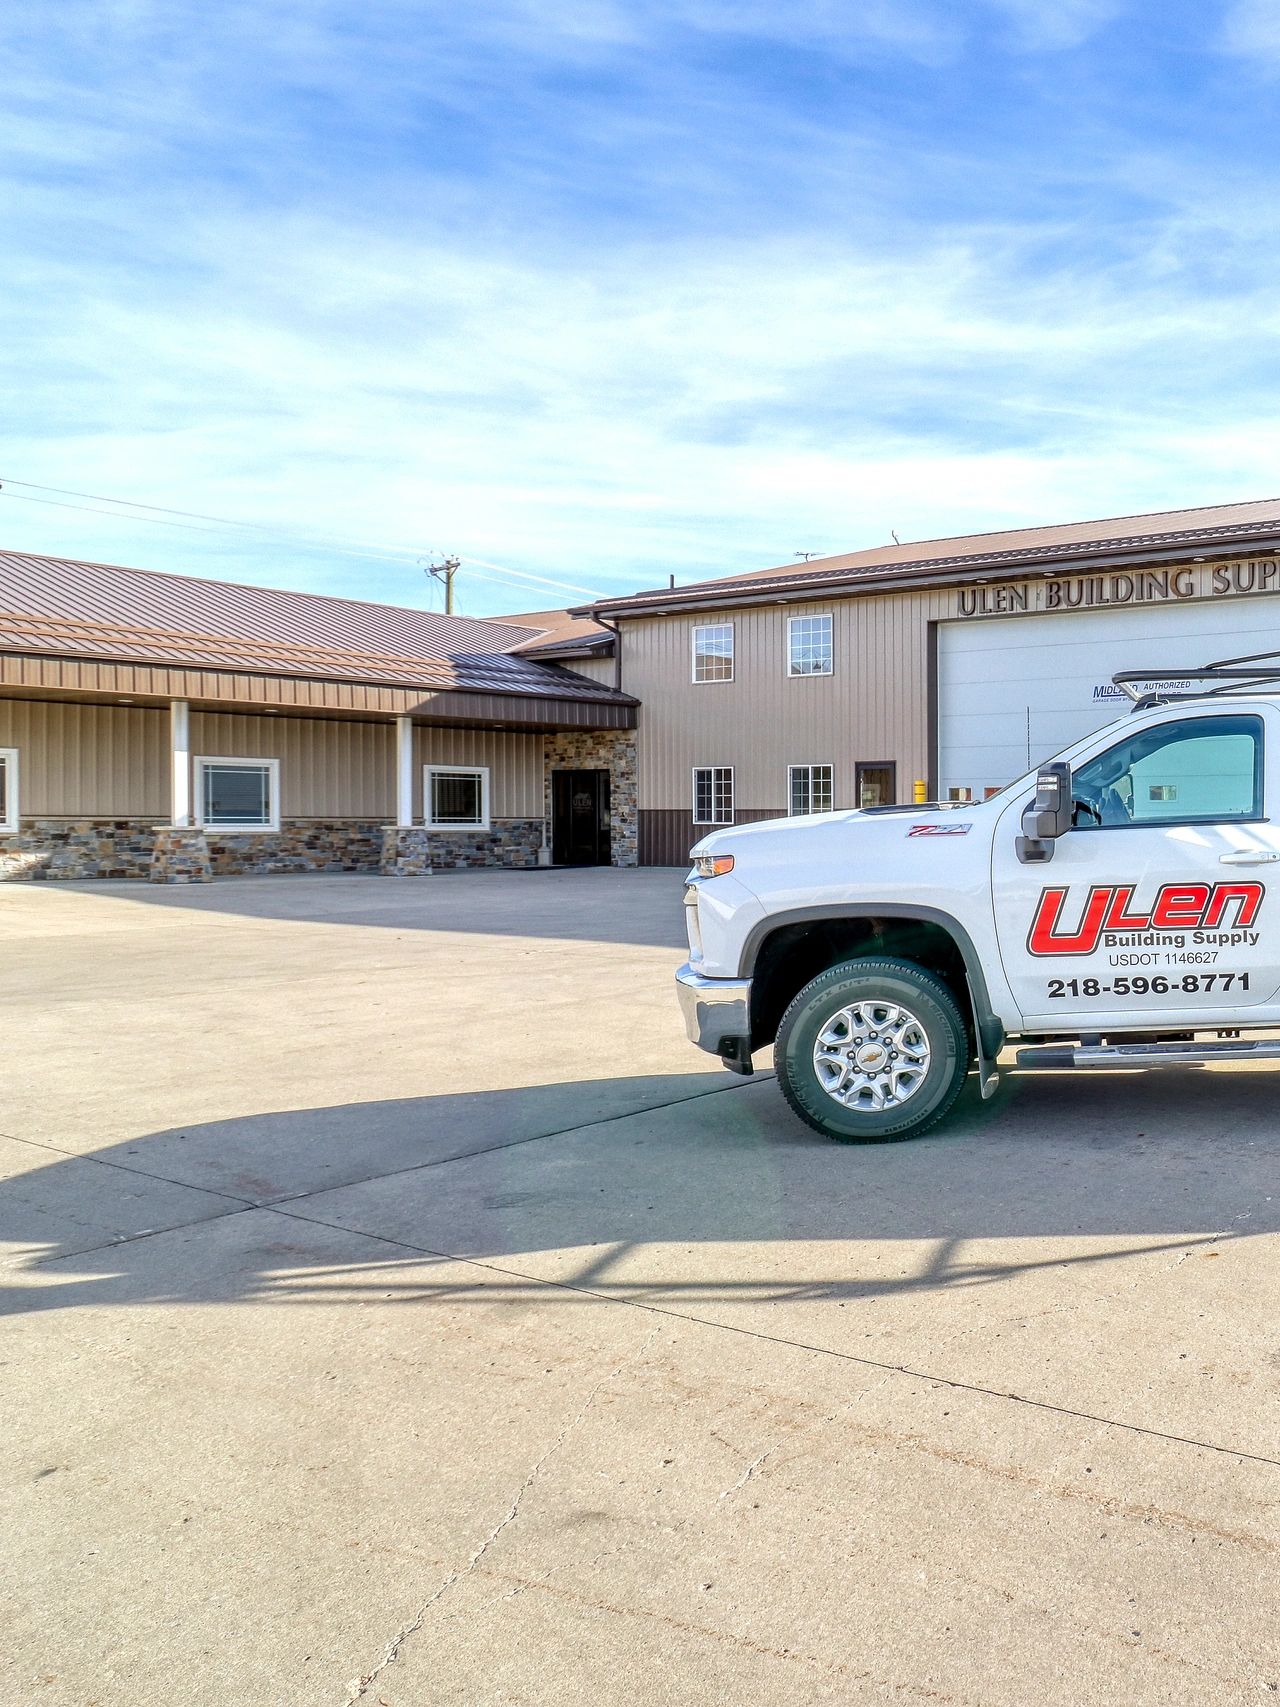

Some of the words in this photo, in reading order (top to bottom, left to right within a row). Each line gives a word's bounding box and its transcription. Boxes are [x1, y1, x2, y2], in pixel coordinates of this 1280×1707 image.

[957, 583, 1029, 616] ULEN
[1045, 567, 1194, 609] BUILDING
[1093, 684, 1138, 698] MIDLD
[1143, 681, 1191, 690] AUTHORIZED
[1104, 933, 1186, 948] Building
[1192, 931, 1260, 947] Supply
[1109, 953, 1160, 966] USDOT
[1164, 951, 1219, 965] 1146627
[1047, 972, 1250, 998] 218-596-8771
